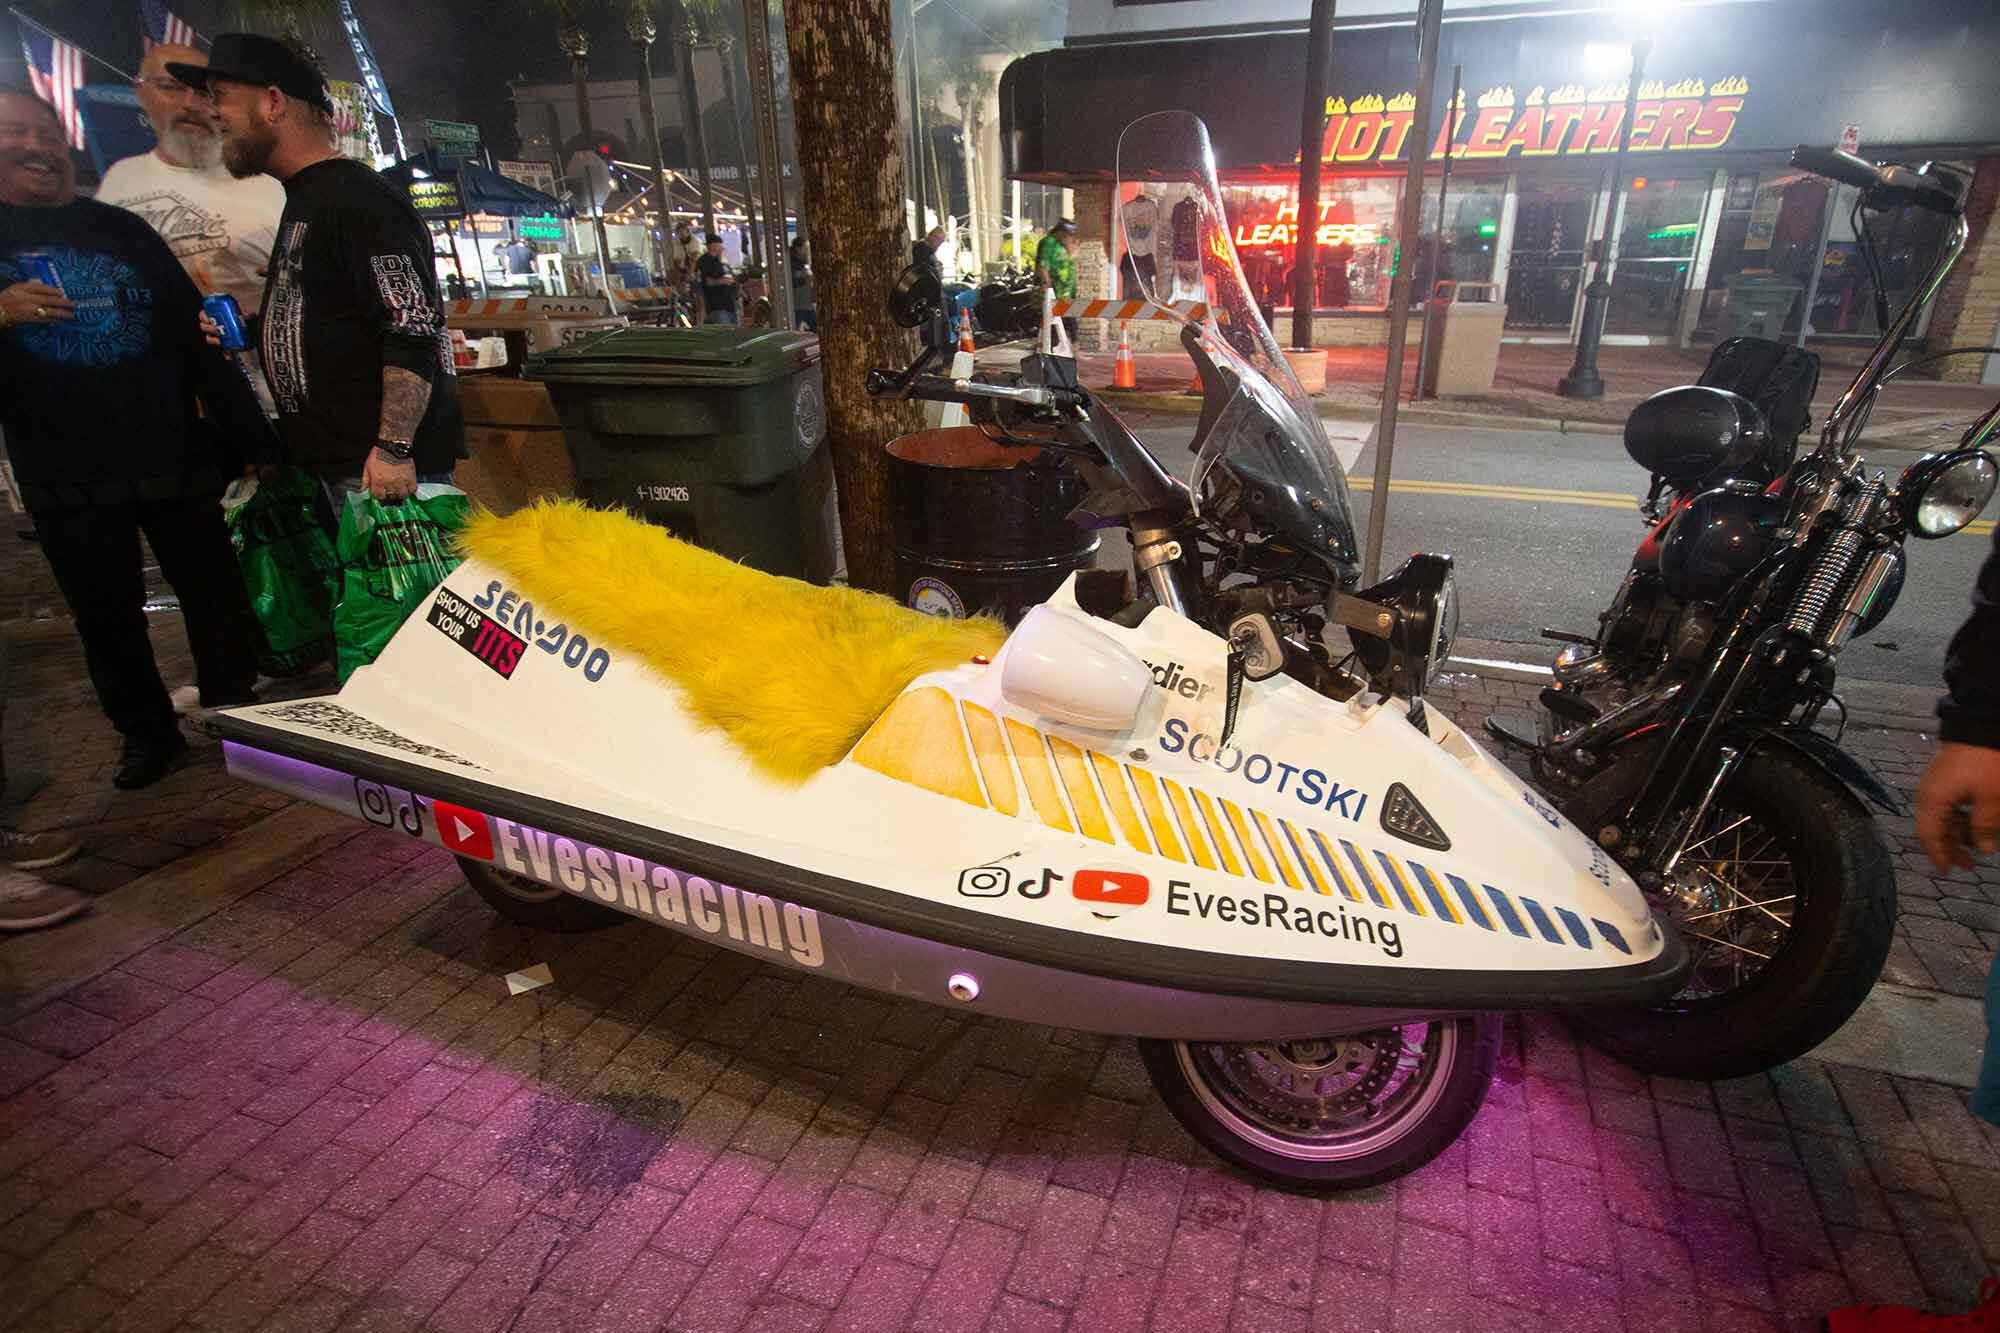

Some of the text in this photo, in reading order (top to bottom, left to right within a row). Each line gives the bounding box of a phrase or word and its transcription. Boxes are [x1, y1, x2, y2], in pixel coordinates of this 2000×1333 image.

[1430, 97, 1744, 159] LEATHERS
[1235, 224, 1377, 247] LEATERS
[1277, 200, 1337, 222] HT
[436, 590, 481, 629] SHOW US
[436, 612, 465, 641] YOUR
[471, 618, 524, 674] TITS
[1159, 718, 1368, 823] SCOOTSKI
[496, 816, 825, 968] EvesRacing
[1167, 879, 1403, 959] EvesRacing
